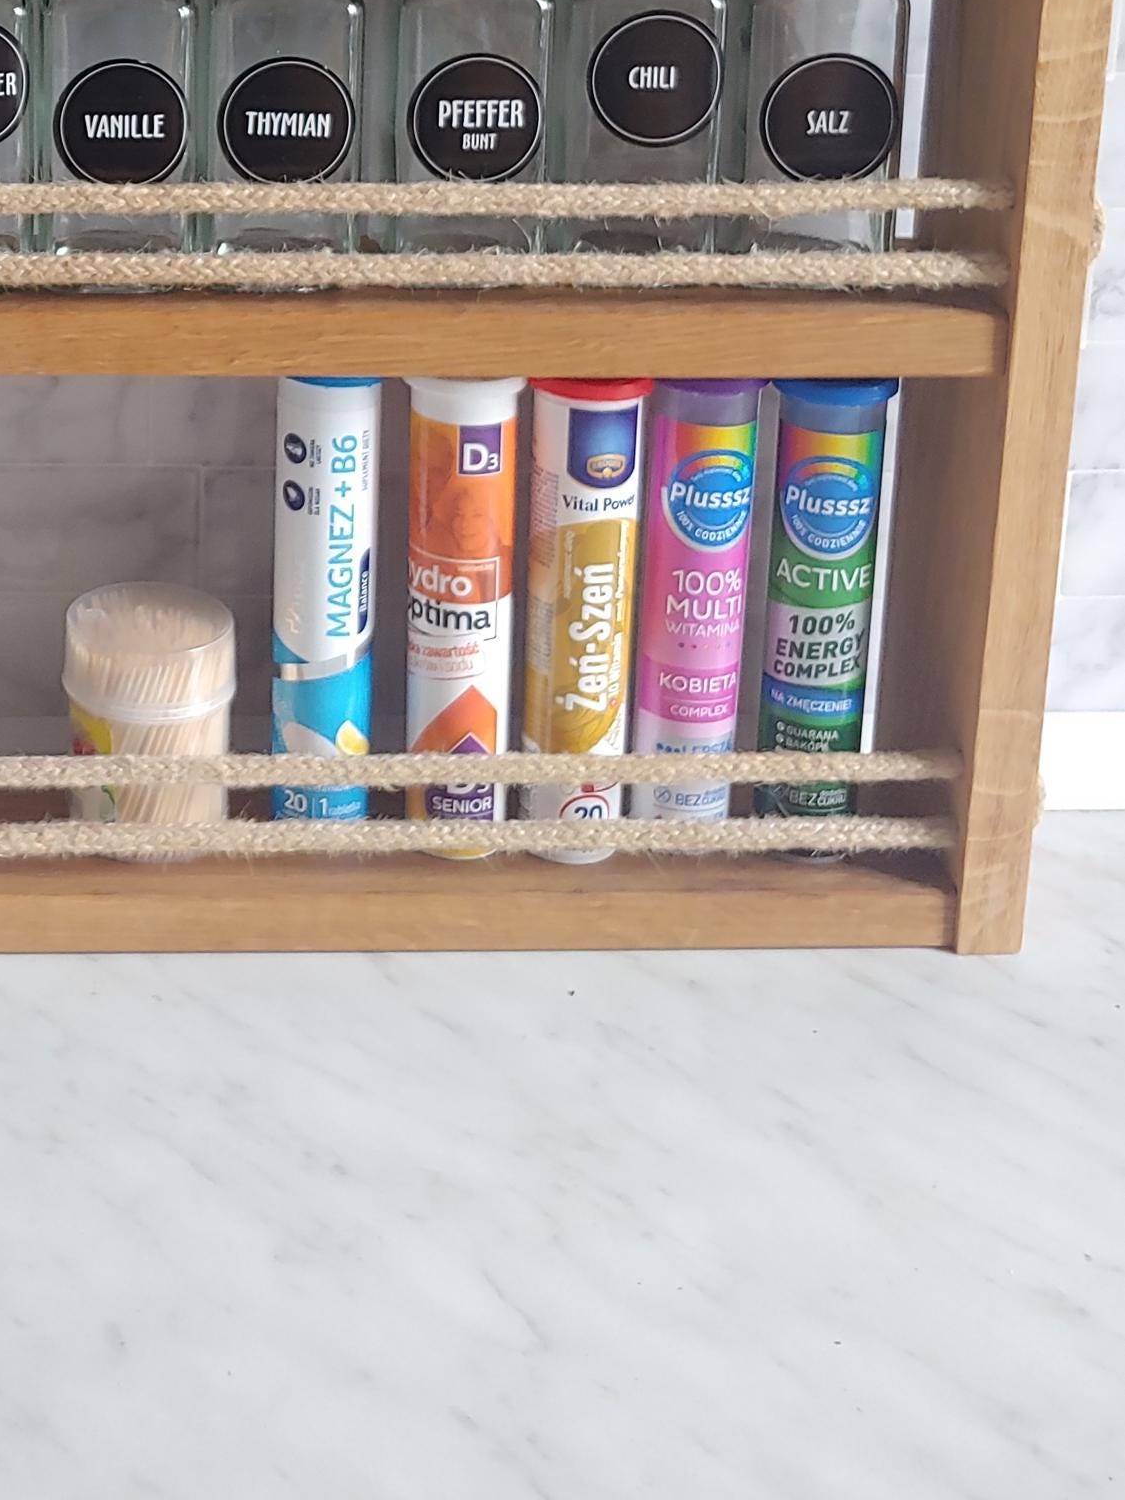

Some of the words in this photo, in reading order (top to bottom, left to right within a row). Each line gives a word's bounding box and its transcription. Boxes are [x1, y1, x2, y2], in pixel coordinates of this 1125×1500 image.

[628, 65, 677, 90] CHILI
[84, 113, 165, 139] VANILLE
[245, 110, 331, 138] THYMIAN
[438, 99, 524, 129] PFEFFER
[805, 109, 849, 135] SALZ
[461, 132, 496, 151] BUNT
[331, 434, 358, 474] B6
[462, 443, 498, 471] D3
[562, 494, 598, 511] Vital
[603, 494, 635, 511] Power
[670, 481, 752, 508] Plusssz
[785, 485, 873, 516] Plusssz
[327, 504, 354, 637] MAGNEZ
[408, 560, 472, 597] ydro
[672, 570, 742, 595] 100%
[776, 558, 871, 592] ACTIVE
[358, 570, 369, 612] Balance
[408, 597, 491, 630] ptima
[666, 595, 742, 621] MULTI
[666, 618, 740, 637] WITAMINA
[789, 610, 855, 635] 100%
[555, 563, 614, 712] Żeń-Szeń
[776, 628, 864, 660] ENERGY
[774, 658, 861, 679] COMPLEX
[659, 671, 737, 693] KOBIETA
[670, 703, 730, 718] COMPLEX
[786, 725, 839, 740] GUARANA
[284, 789, 308, 813] 20
[432, 796, 492, 813] SENIOR
